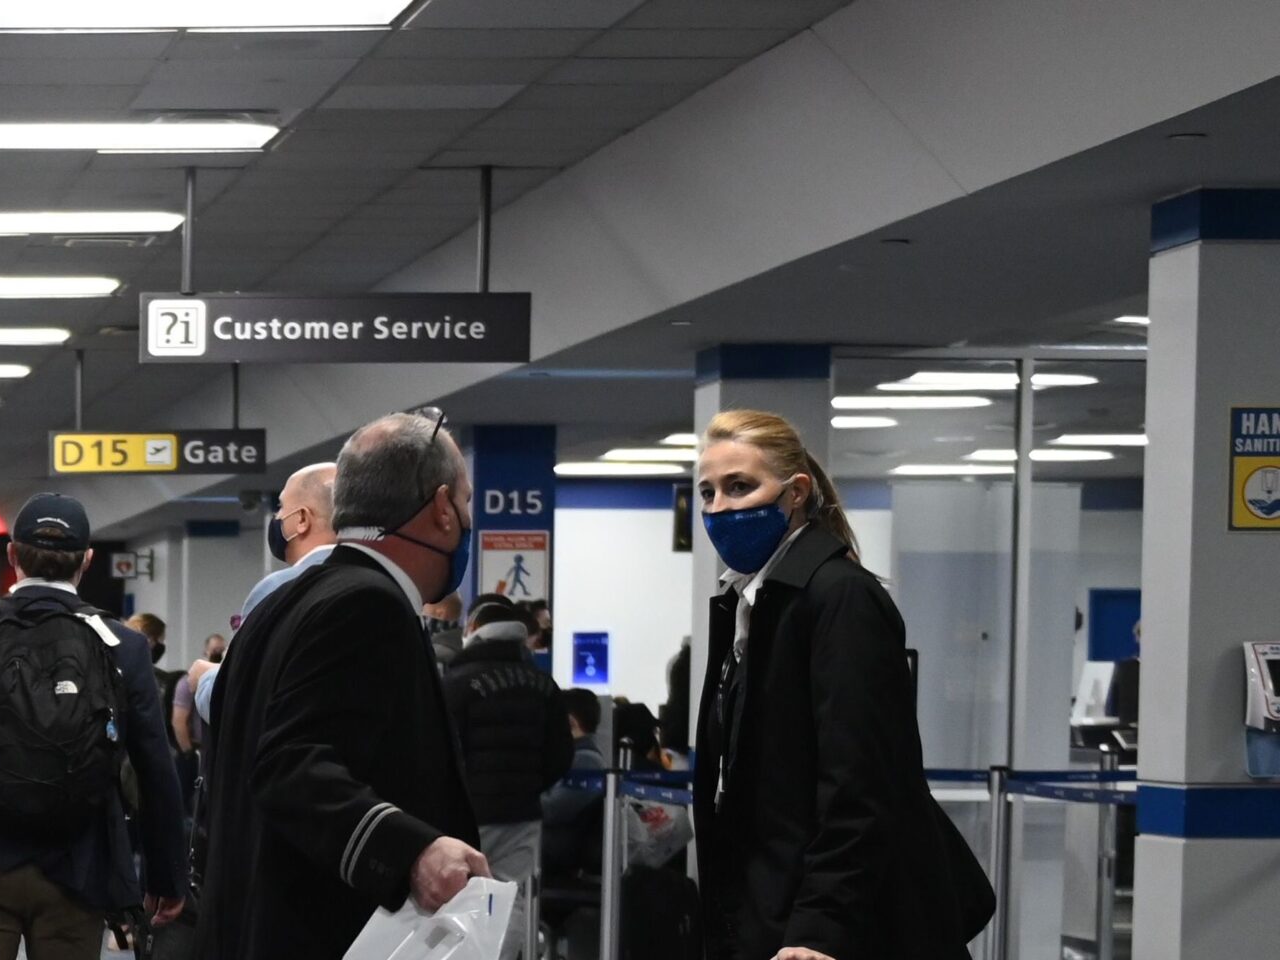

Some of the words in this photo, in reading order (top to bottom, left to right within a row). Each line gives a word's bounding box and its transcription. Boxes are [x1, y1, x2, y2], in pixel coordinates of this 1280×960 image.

[213, 316, 363, 341] Customer
[373, 316, 487, 341] Service
[1241, 413, 1280, 435] HAN
[61, 440, 129, 467] D15
[183, 440, 257, 464] Gate
[1234, 438, 1280, 452] SANITI
[485, 490, 543, 514] D15
